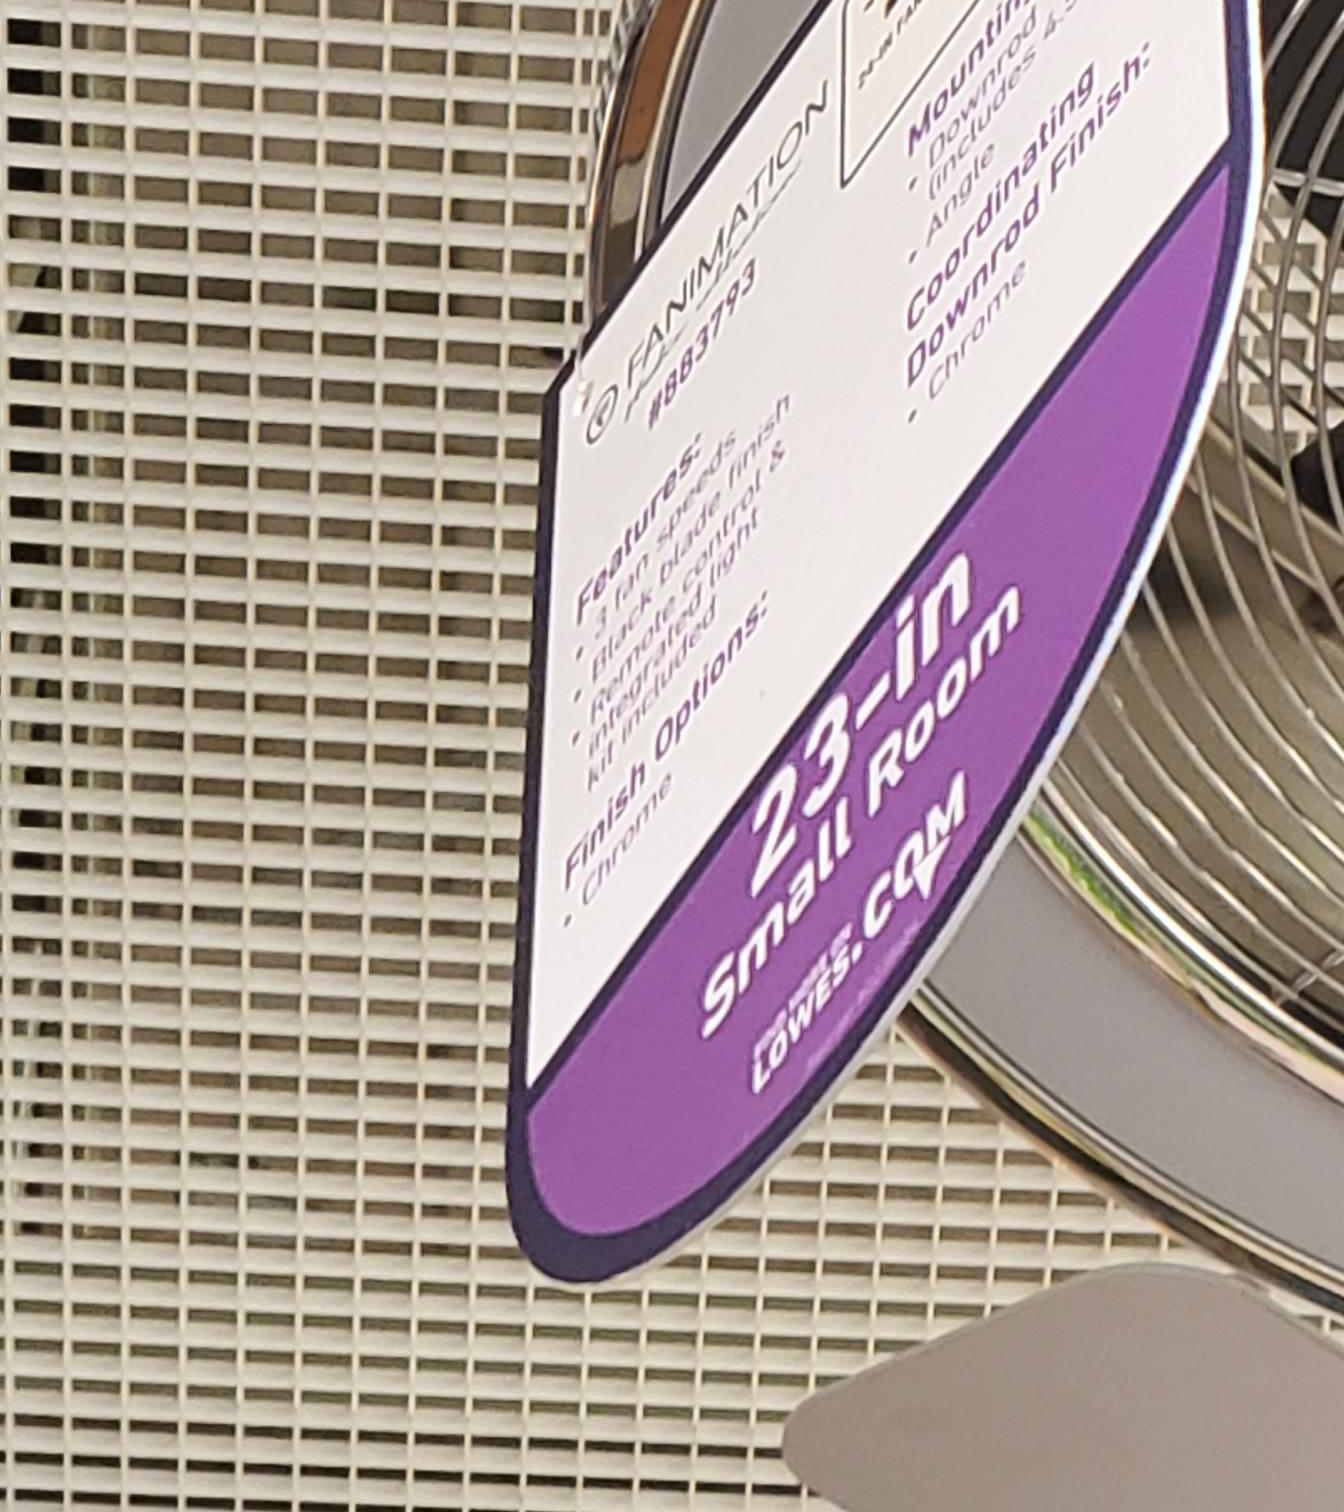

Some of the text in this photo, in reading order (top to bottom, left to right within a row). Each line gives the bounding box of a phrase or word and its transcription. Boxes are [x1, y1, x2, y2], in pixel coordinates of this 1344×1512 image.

[906, 61, 1094, 330] Coordinating
[926, 142, 995, 249] Angle
[928, 3, 1036, 169] Downrod
[928, 46, 1036, 201] (includes
[628, 79, 828, 390] FANIMATION
[906, 181, 1041, 388] Downrod
[1050, 40, 1150, 194] Finish:
[928, 259, 1027, 400] Chrome
[649, 257, 756, 429] #883793
[577, 431, 702, 627] Features:
[589, 507, 758, 760] integrated light
[591, 439, 785, 725] Remote control &
[592, 394, 789, 684] Black blade finish
[615, 552, 648, 611] fan
[657, 428, 736, 553] speeds
[565, 589, 767, 891] Finish Options:
[588, 594, 715, 792] kit included
[701, 797, 850, 1039] Small
[867, 585, 1020, 818] Room
[751, 551, 971, 899] 23-in
[582, 773, 671, 906] Chrome
[752, 769, 967, 1094] LOWES.COM
